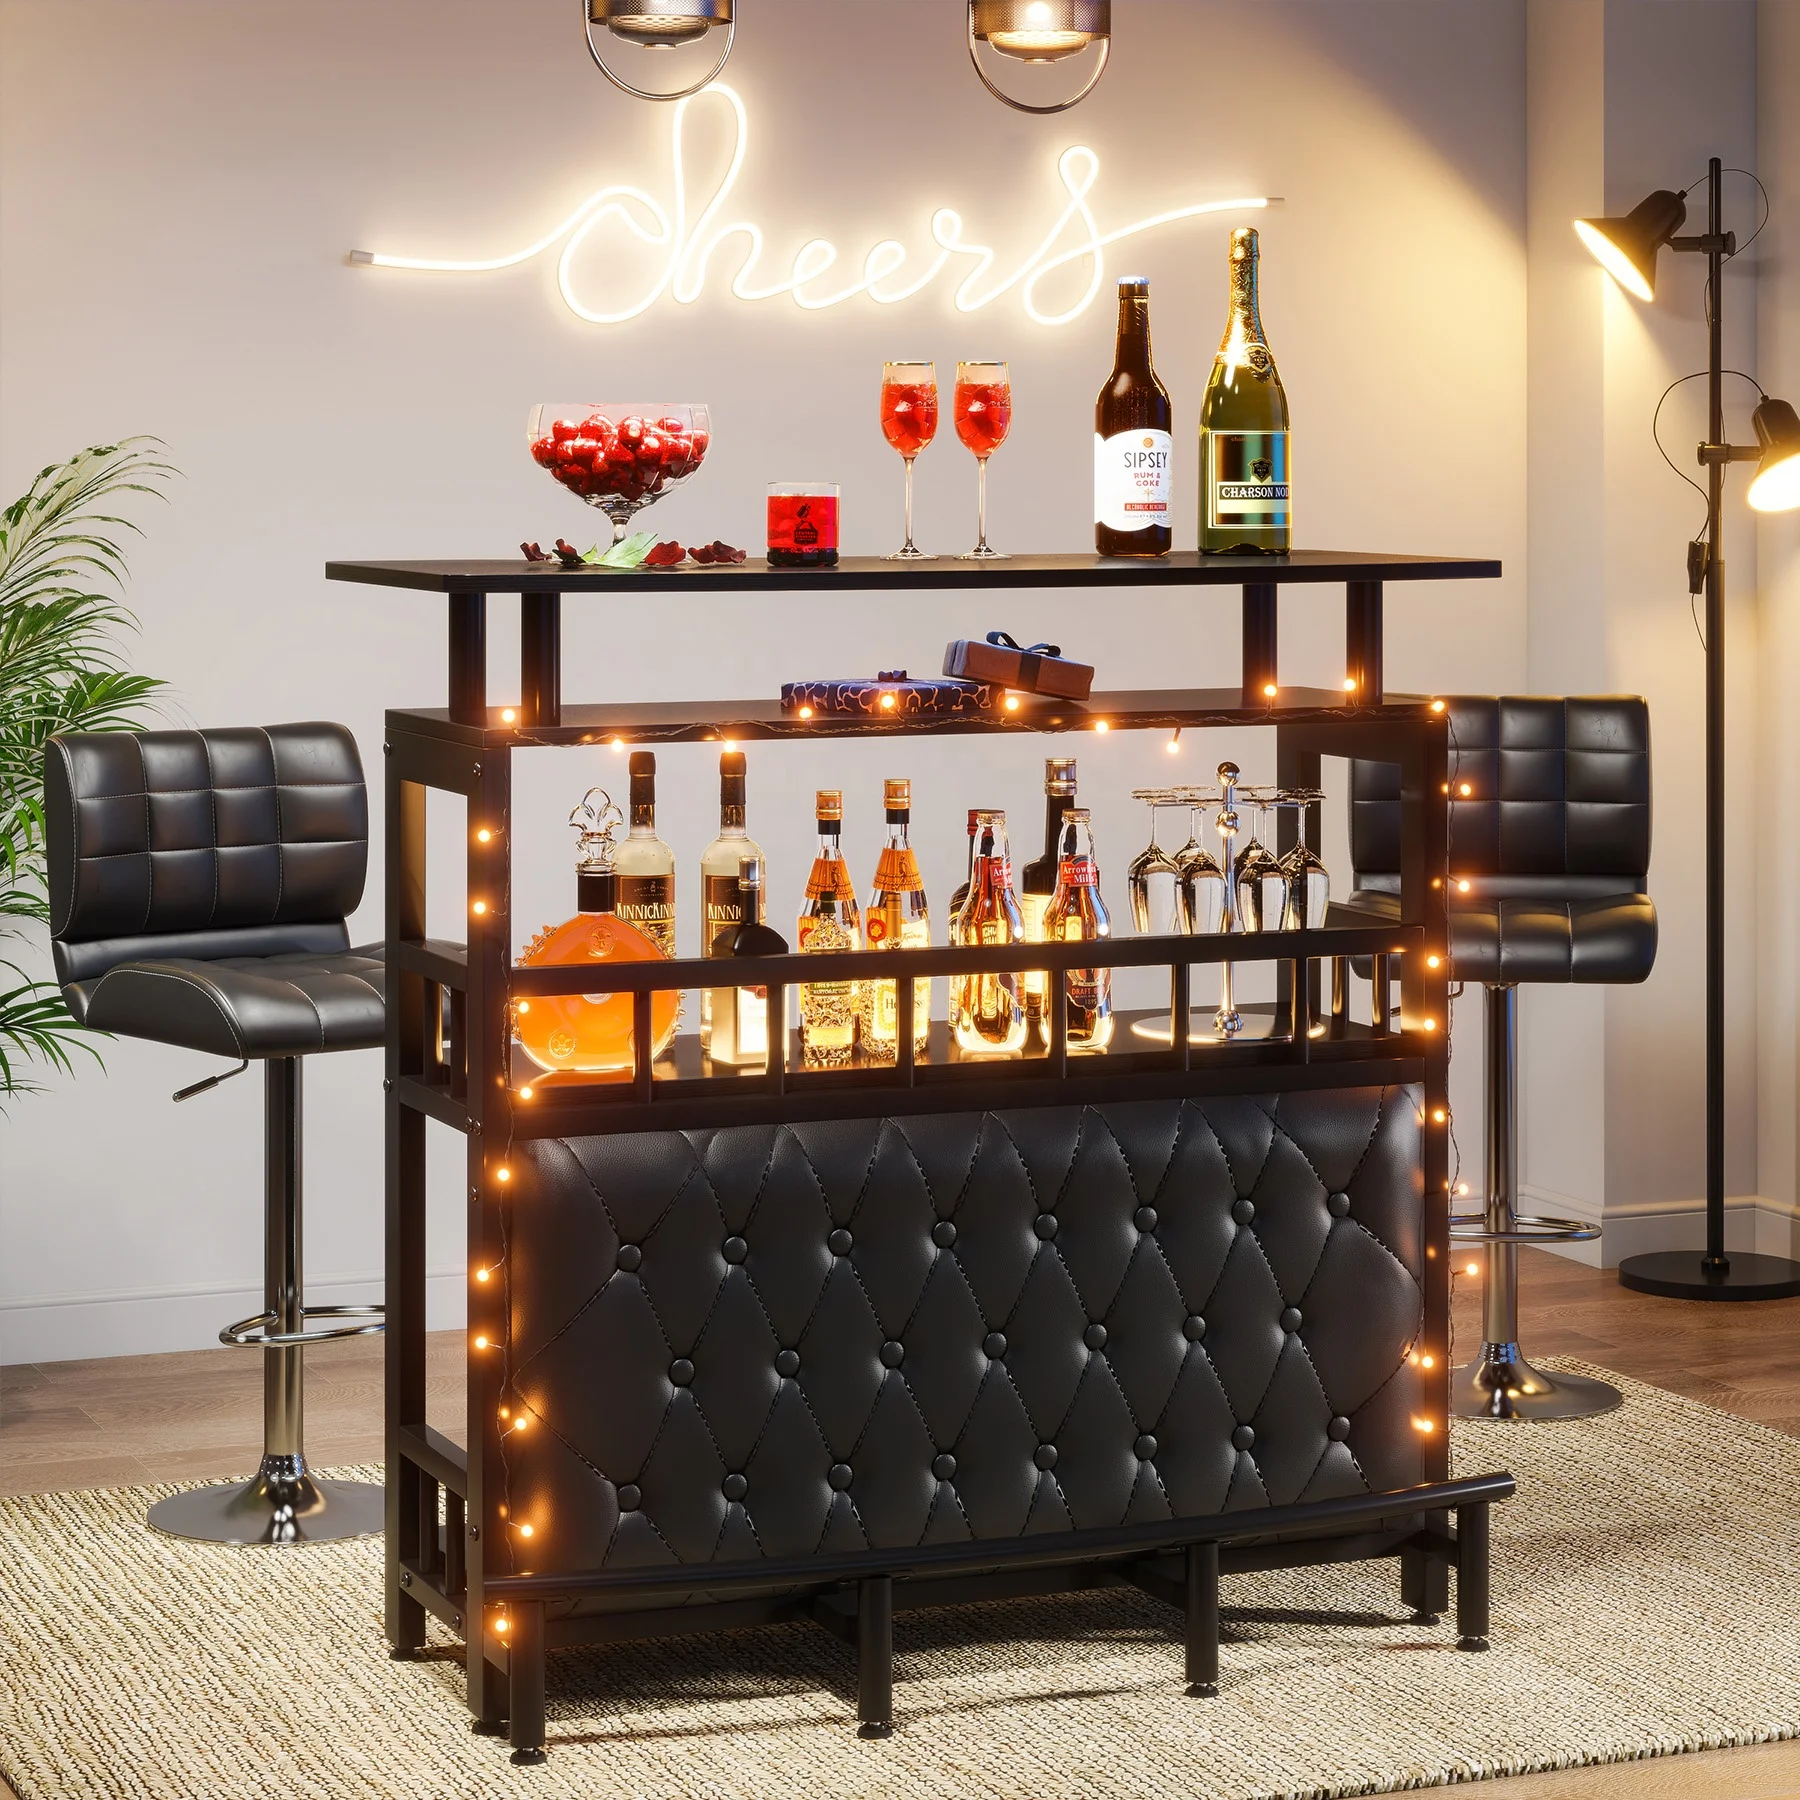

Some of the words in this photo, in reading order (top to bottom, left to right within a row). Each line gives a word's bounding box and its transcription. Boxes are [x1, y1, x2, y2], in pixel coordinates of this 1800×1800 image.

[1124, 452, 1168, 468] SIPSEY
[1221, 487, 1274, 498] CHARSON
[1073, 874, 1096, 883] Mills
